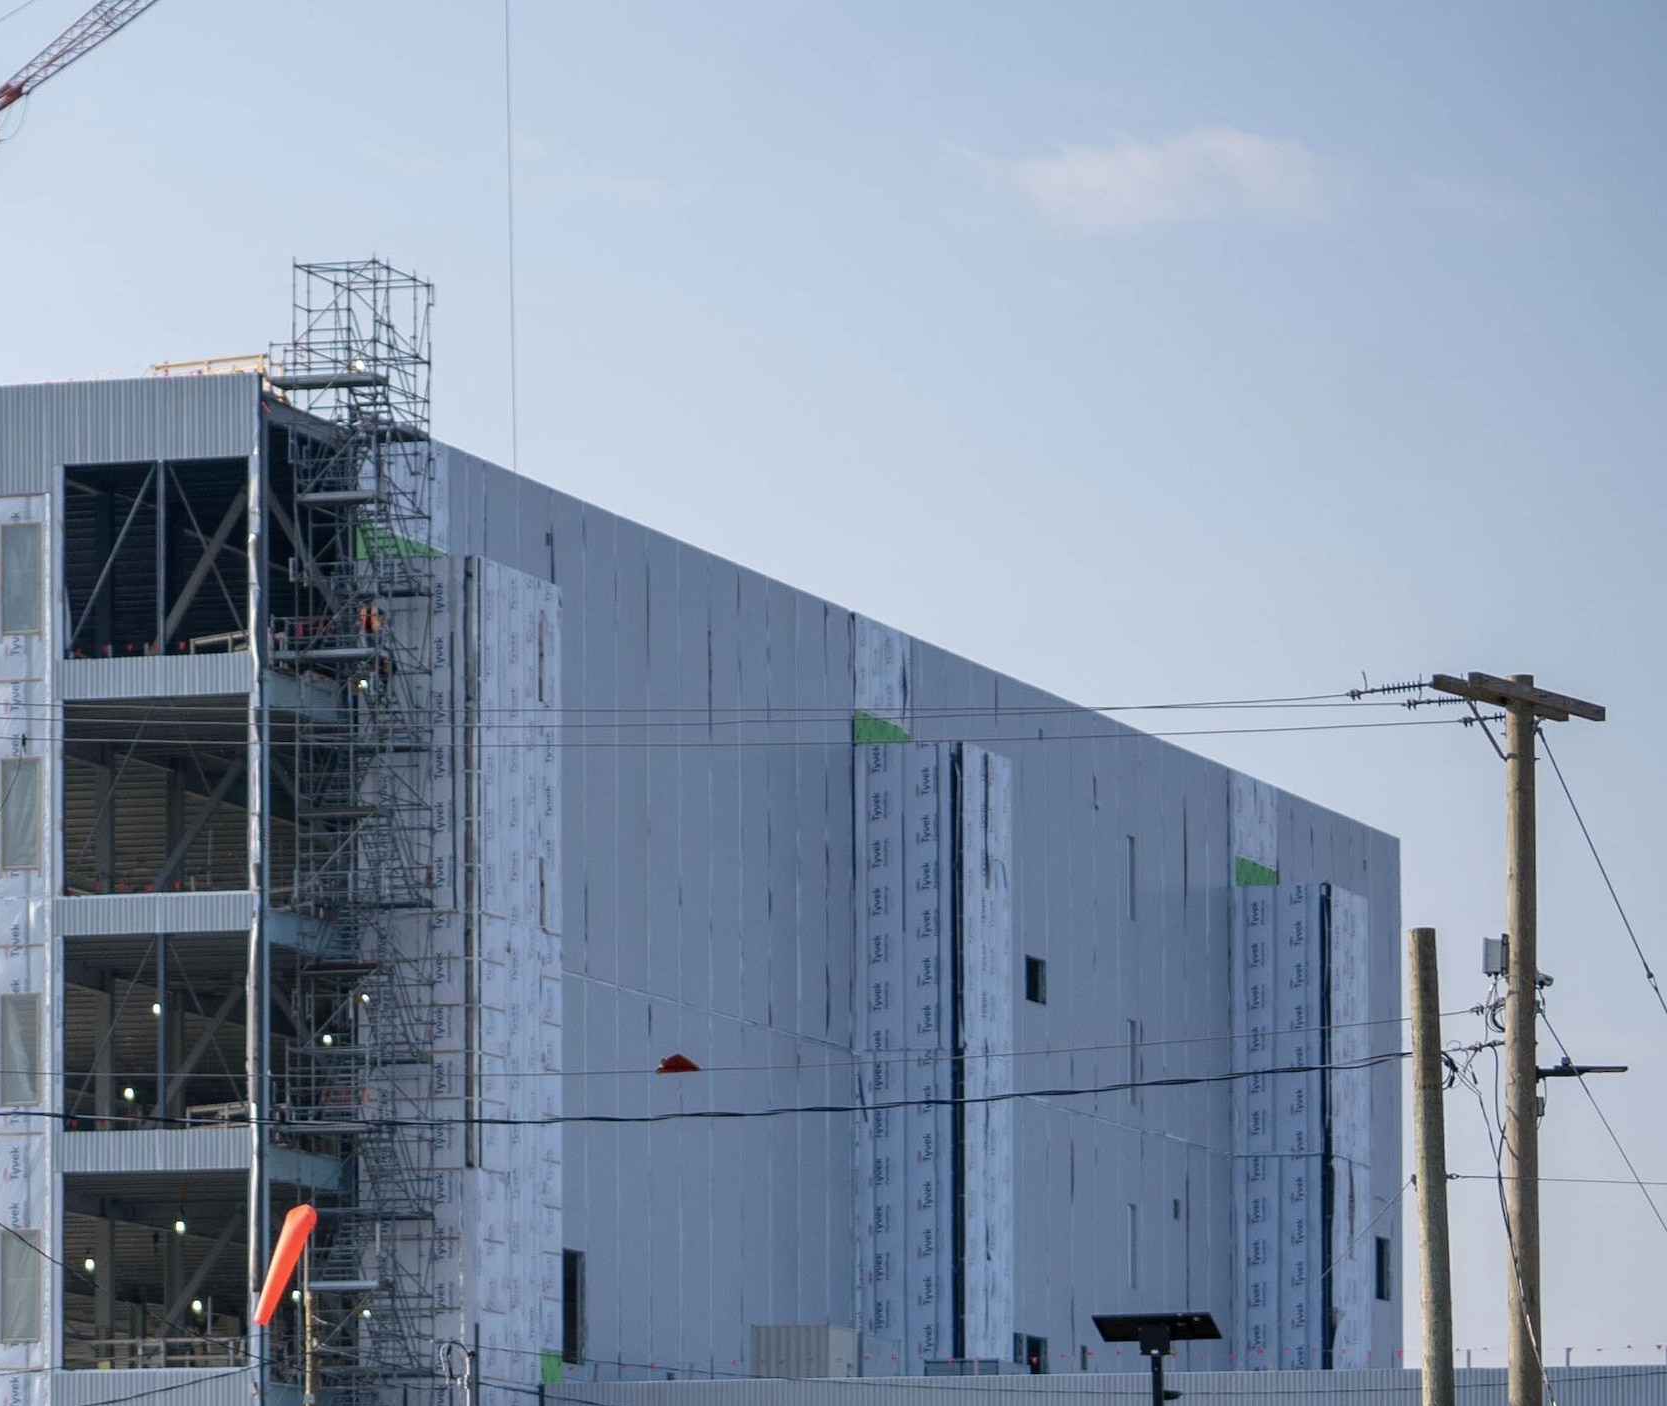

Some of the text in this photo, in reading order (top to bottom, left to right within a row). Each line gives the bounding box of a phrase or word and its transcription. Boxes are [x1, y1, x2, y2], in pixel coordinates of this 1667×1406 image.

[434, 583, 445, 615] Tyvek
[434, 637, 445, 669] Tyvek
[434, 747, 444, 780] Tyvek
[921, 767, 931, 795] Tyvek
[434, 802, 444, 834] Tyvek
[871, 793, 881, 821] Tyvek
[921, 814, 931, 843] Tyvek
[872, 840, 882, 868] Tyvek
[434, 856, 444, 888] Tyvek
[921, 862, 931, 890] Tyvek
[872, 888, 882, 916] Tyvek
[1250, 901, 1259, 926] Tyvek
[921, 910, 931, 938] Tyvek
[1294, 920, 1303, 947] Tyvek
[872, 935, 882, 963] Tyvek
[1250, 942, 1259, 968] Tyvek
[921, 957, 931, 986] Tyvek
[1294, 962, 1303, 988] Tyvek
[872, 983, 882, 1011] Tyvek
[1250, 985, 1259, 1010] Tyvek
[921, 1005, 931, 1033] Tyvek
[1295, 1005, 1304, 1030] Tyvek
[434, 1062, 444, 1095] Tyvek
[874, 1062, 883, 1091] Tyvek
[1295, 1089, 1304, 1114] Tyvek
[874, 1110, 883, 1138] Tyvek
[1251, 1111, 1259, 1136] Tyvek
[923, 1133, 932, 1162] Tyvek
[9, 1148, 20, 1180] Tyvek
[874, 1158, 883, 1186] Tyvek
[435, 1173, 445, 1205] Tyvek
[923, 1181, 932, 1209] Tyvek
[1295, 1177, 1305, 1202] Tyvek
[874, 1205, 883, 1233] Tyvek
[1251, 1198, 1260, 1223] Tyvek
[923, 1229, 933, 1257] Tyvek
[1295, 1219, 1305, 1244] Tyvek
[875, 1253, 884, 1281] Tyvek
[1251, 1241, 1260, 1265] Tyvek
[1295, 1261, 1305, 1286] Tyvek
[923, 1276, 933, 1305] Tyvek
[1251, 1282, 1260, 1307] Tyvek
[875, 1301, 884, 1329] Tyvek
[1295, 1303, 1305, 1328] Tyvek
[923, 1324, 933, 1352] Tyvek
[1295, 1345, 1305, 1369] Tyvek
